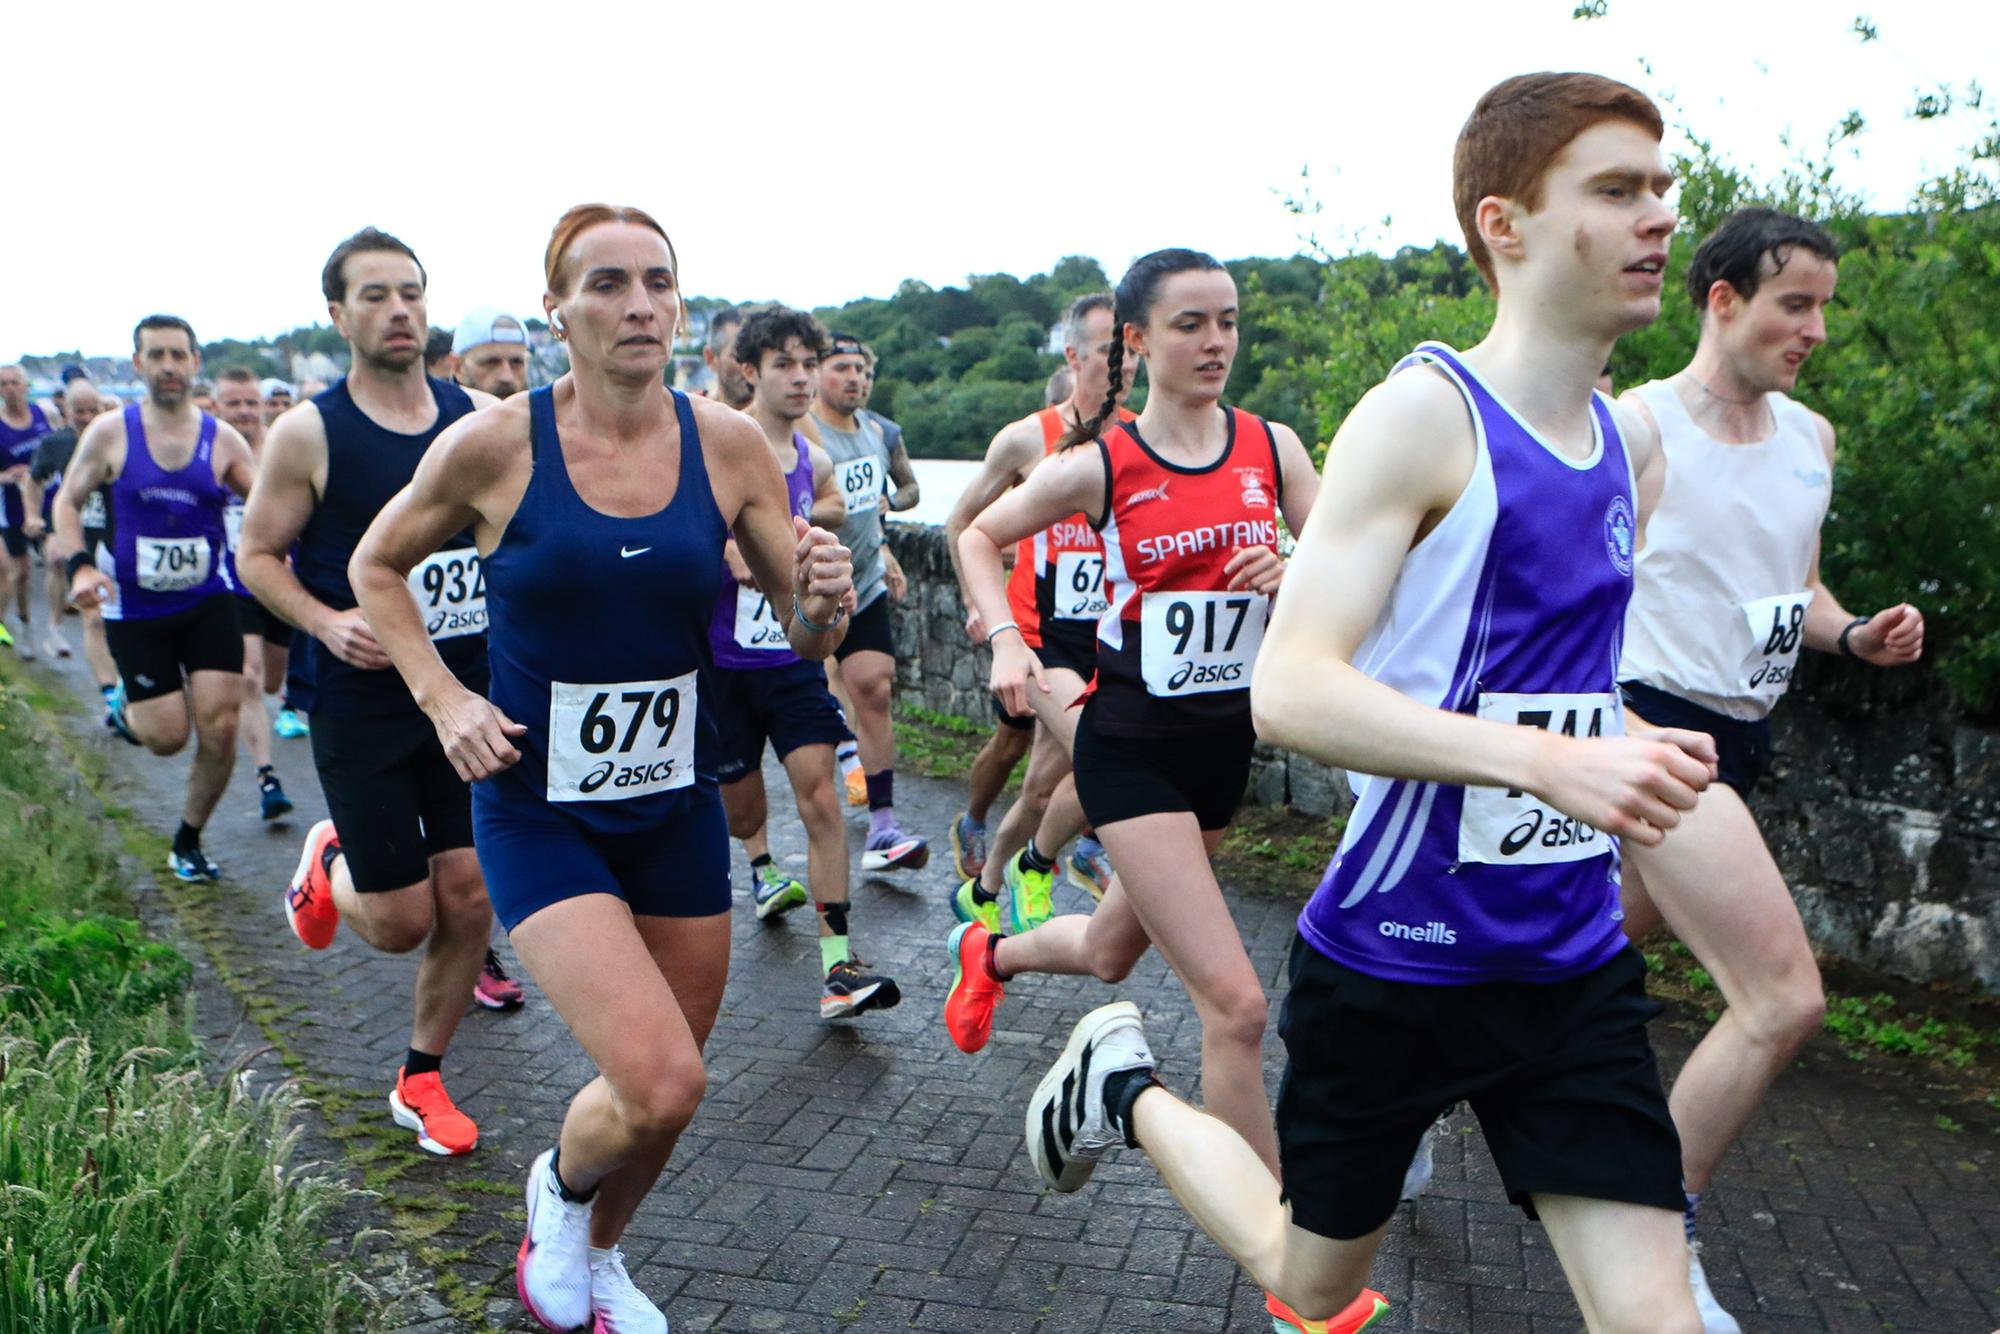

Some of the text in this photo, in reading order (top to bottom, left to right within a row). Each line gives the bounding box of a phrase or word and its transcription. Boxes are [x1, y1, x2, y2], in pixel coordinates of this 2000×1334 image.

[846, 462, 873, 492] 659
[151, 544, 198, 571] 704
[1136, 520, 1276, 565] SPARTANS
[423, 555, 486, 607] 932
[1072, 559, 1104, 593] 67
[448, 609, 486, 630] asic
[1166, 598, 1251, 655] 917
[1193, 662, 1244, 684] asics
[579, 687, 680, 754] 679
[614, 758, 675, 788] asics
